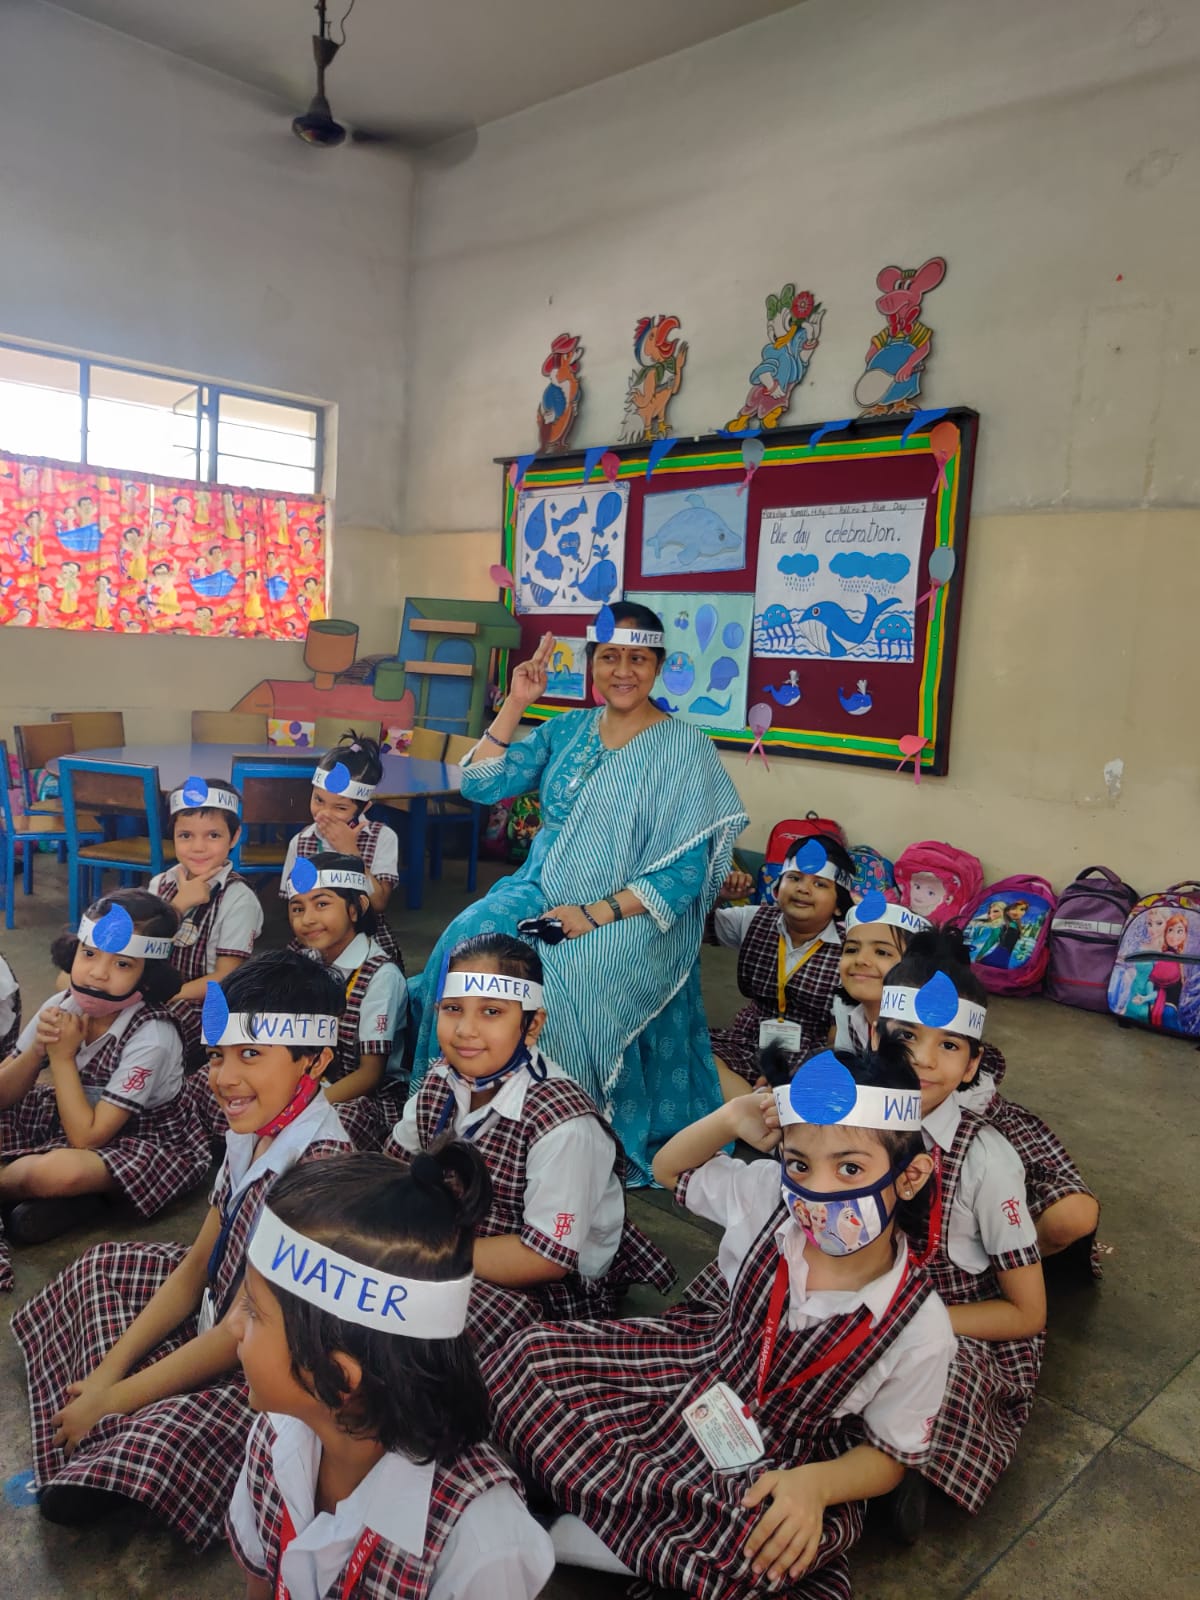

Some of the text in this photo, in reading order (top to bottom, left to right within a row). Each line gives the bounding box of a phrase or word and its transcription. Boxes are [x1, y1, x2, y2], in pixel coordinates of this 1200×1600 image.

[793, 519, 811, 551] day
[218, 791, 238, 808] WAT
[464, 974, 531, 999] WATER
[880, 990, 907, 1011] AVE
[253, 1016, 337, 1040] WATER
[271, 1234, 408, 1322] WATER
